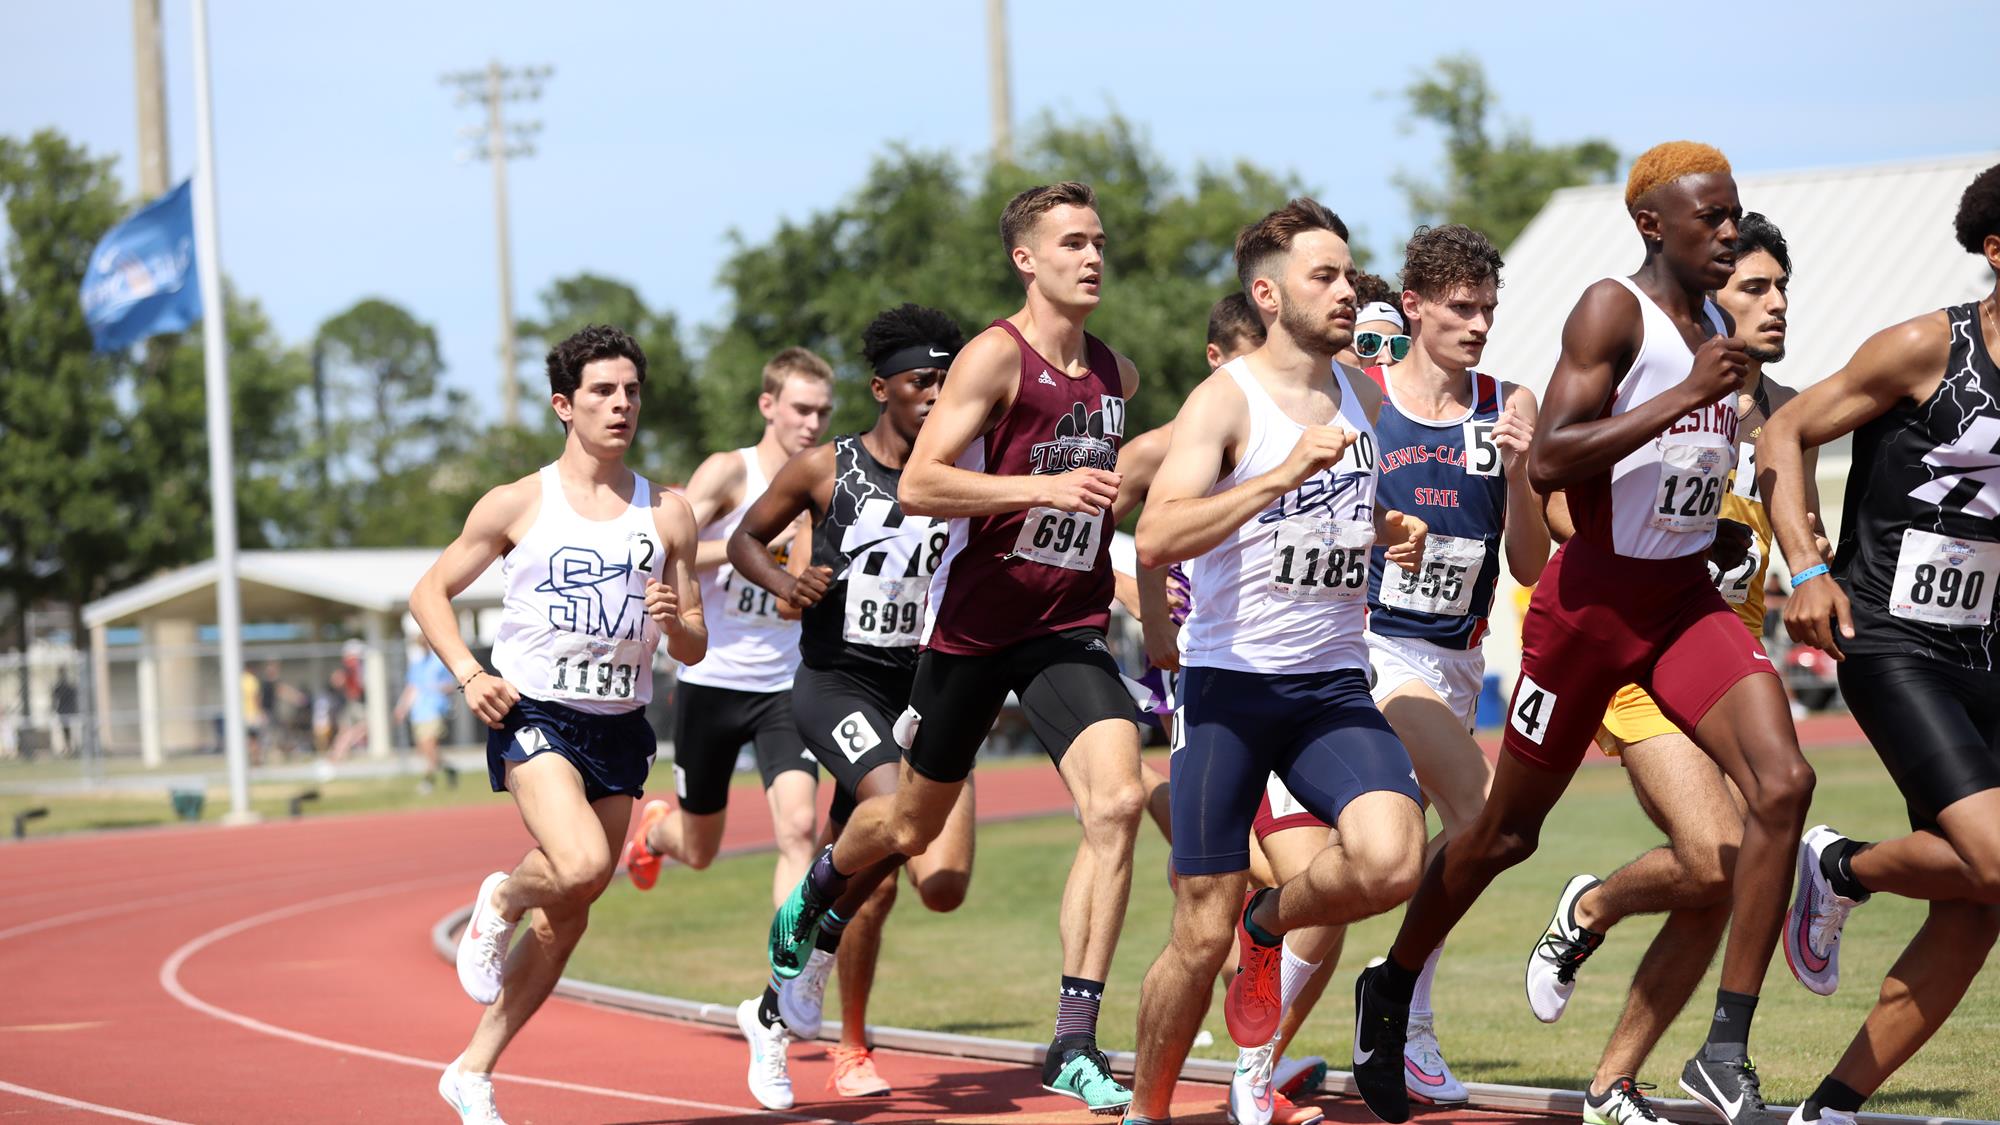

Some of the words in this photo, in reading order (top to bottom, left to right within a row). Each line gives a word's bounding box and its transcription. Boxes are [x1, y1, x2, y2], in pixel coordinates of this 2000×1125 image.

[1106, 399, 1123, 434] 12
[1352, 431, 1374, 470] 10
[1378, 445, 1467, 475] LEWIS-CLA
[1474, 426, 1497, 472] 5
[1415, 487, 1459, 507] STATE
[1659, 475, 1722, 517] 126
[1033, 514, 1092, 557] 694
[638, 539, 654, 573] 2
[1275, 545, 1366, 588] 1185
[738, 586, 776, 617] 81
[1910, 563, 1985, 611] 890
[859, 599, 917, 634] 899
[553, 657, 632, 698] 1193
[1517, 689, 1545, 736] 4
[840, 720, 867, 753] 8
